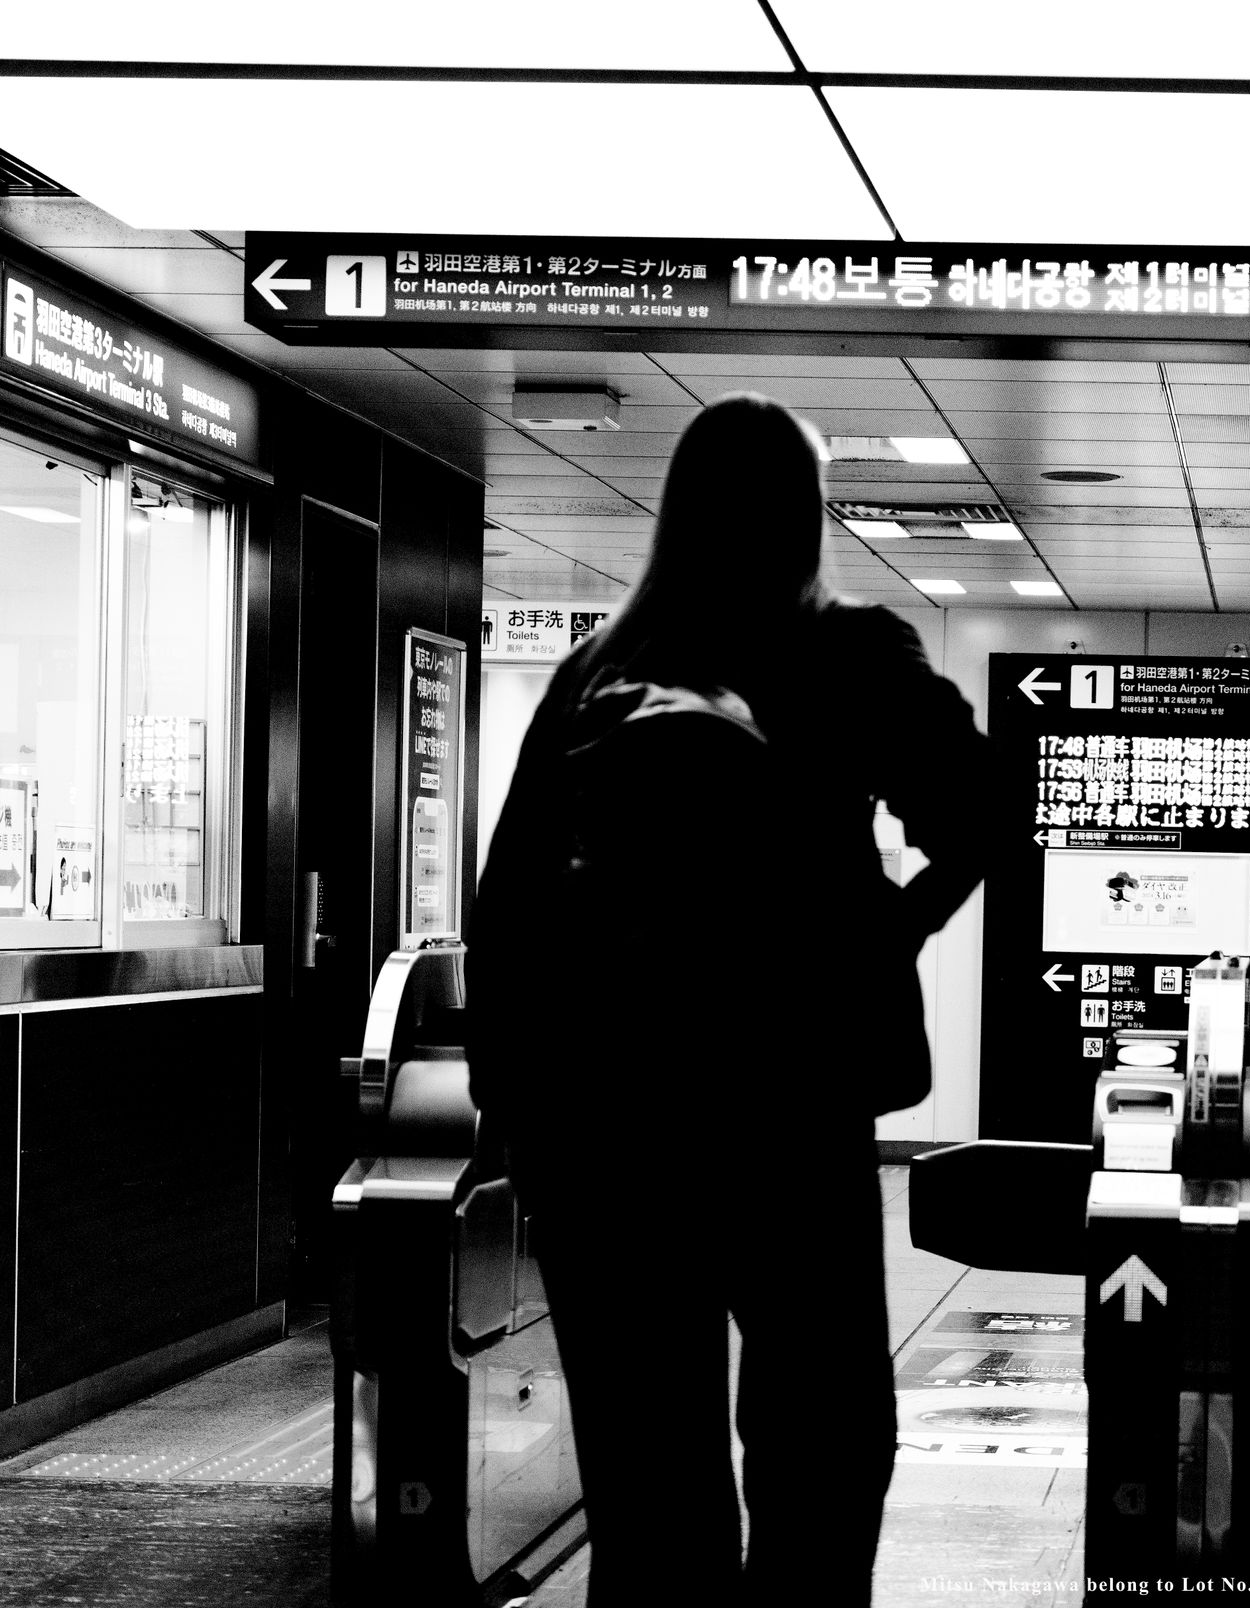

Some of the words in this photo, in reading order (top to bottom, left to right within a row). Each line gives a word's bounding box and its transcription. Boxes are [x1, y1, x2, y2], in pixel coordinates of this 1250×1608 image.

[345, 262, 363, 308] 1
[732, 256, 837, 302] 17:48
[837, 256, 938, 307] 보통
[948, 257, 1095, 309] 하네다공항
[394, 279, 417, 292] for
[424, 280, 490, 294] Haneda
[495, 281, 557, 297] Airport
[562, 282, 634, 298] Terminal
[662, 285, 673, 298] 2
[515, 301, 536, 313] 方向
[547, 301, 600, 315] 하네다공항
[687, 305, 710, 317] 방향
[35, 339, 73, 381] Haneda
[74, 357, 107, 394] Airport
[108, 371, 145, 410] Terminal
[145, 391, 152, 412] 3
[153, 392, 170, 421] Sta.
[507, 609, 564, 628] お手洗
[506, 631, 540, 641] Toilets
[1085, 670, 1098, 704] 1
[1120, 682, 1135, 692] for
[1137, 683, 1177, 693] Haneda
[1179, 684, 1216, 697] Airport
[1112, 965, 1136, 978] 階段
[1112, 977, 1131, 986] Stairs
[1111, 1000, 1146, 1013] お手洗
[1111, 1012, 1134, 1021] Toilets
